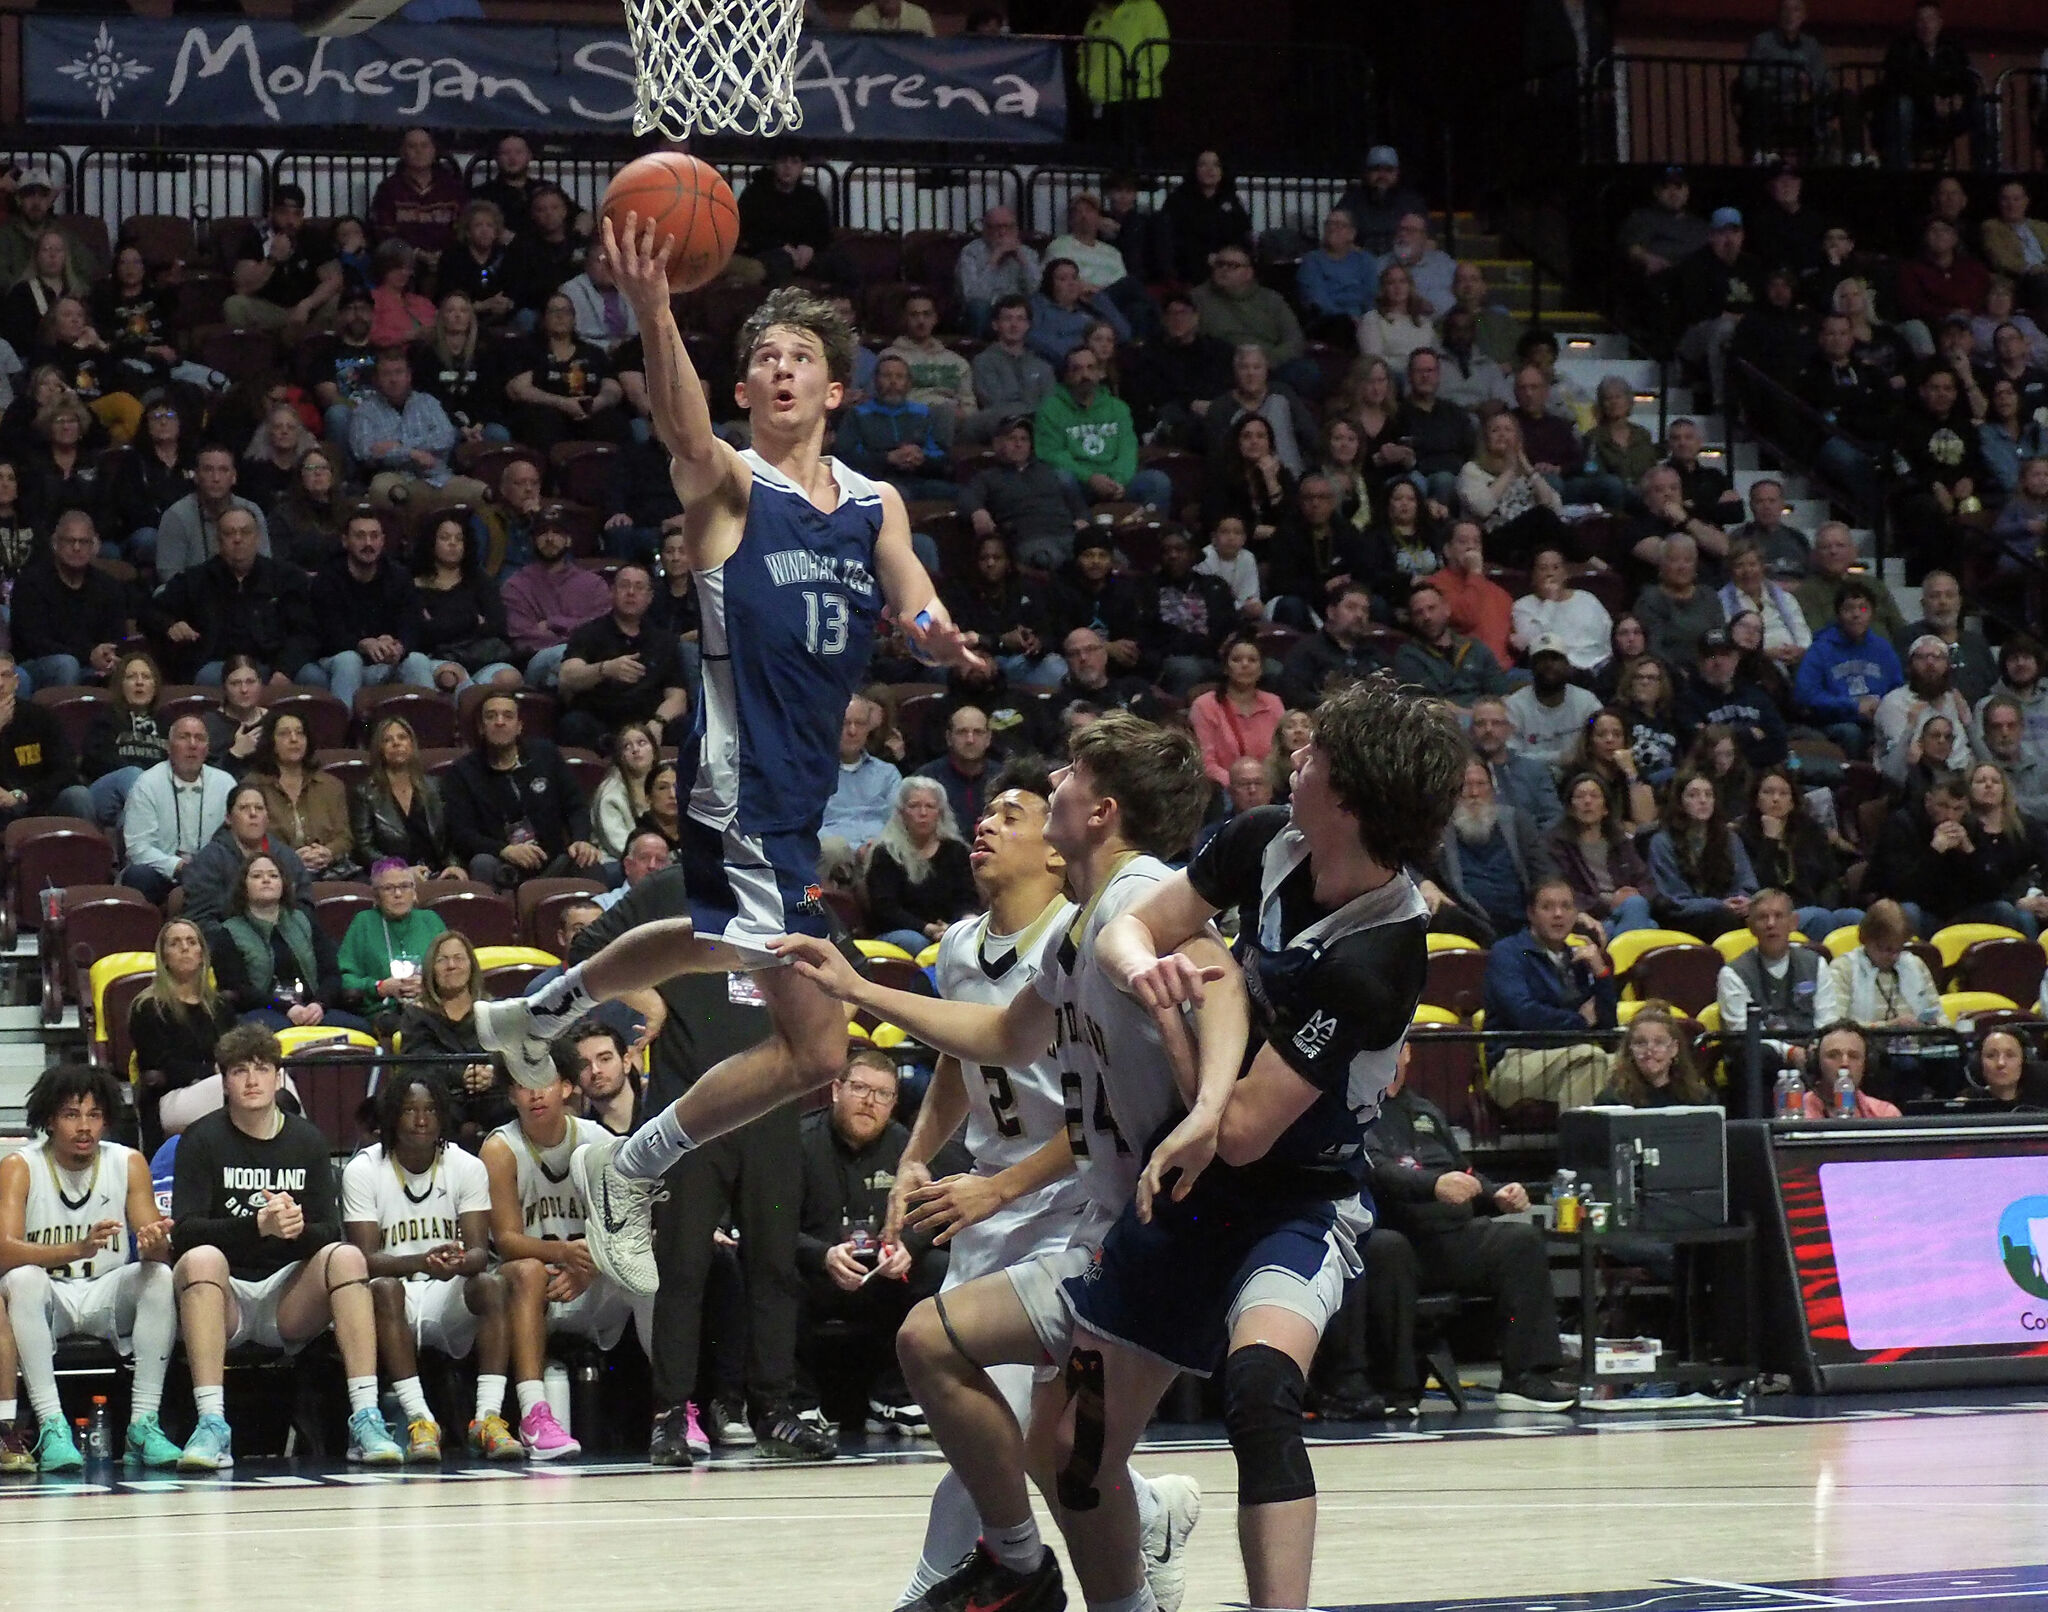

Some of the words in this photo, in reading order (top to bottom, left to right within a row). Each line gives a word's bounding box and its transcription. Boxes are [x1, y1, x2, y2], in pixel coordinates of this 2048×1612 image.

[165, 24, 551, 122] Mohegan
[789, 39, 1040, 134] Arena
[801, 591, 849, 655] 13
[979, 1064, 1027, 1139] 2
[1060, 1070, 1132, 1157] 24
[223, 1166, 307, 1191] WOODLAND
[27, 1223, 120, 1253] WOODLD
[2020, 1311, 2048, 1331] Co
